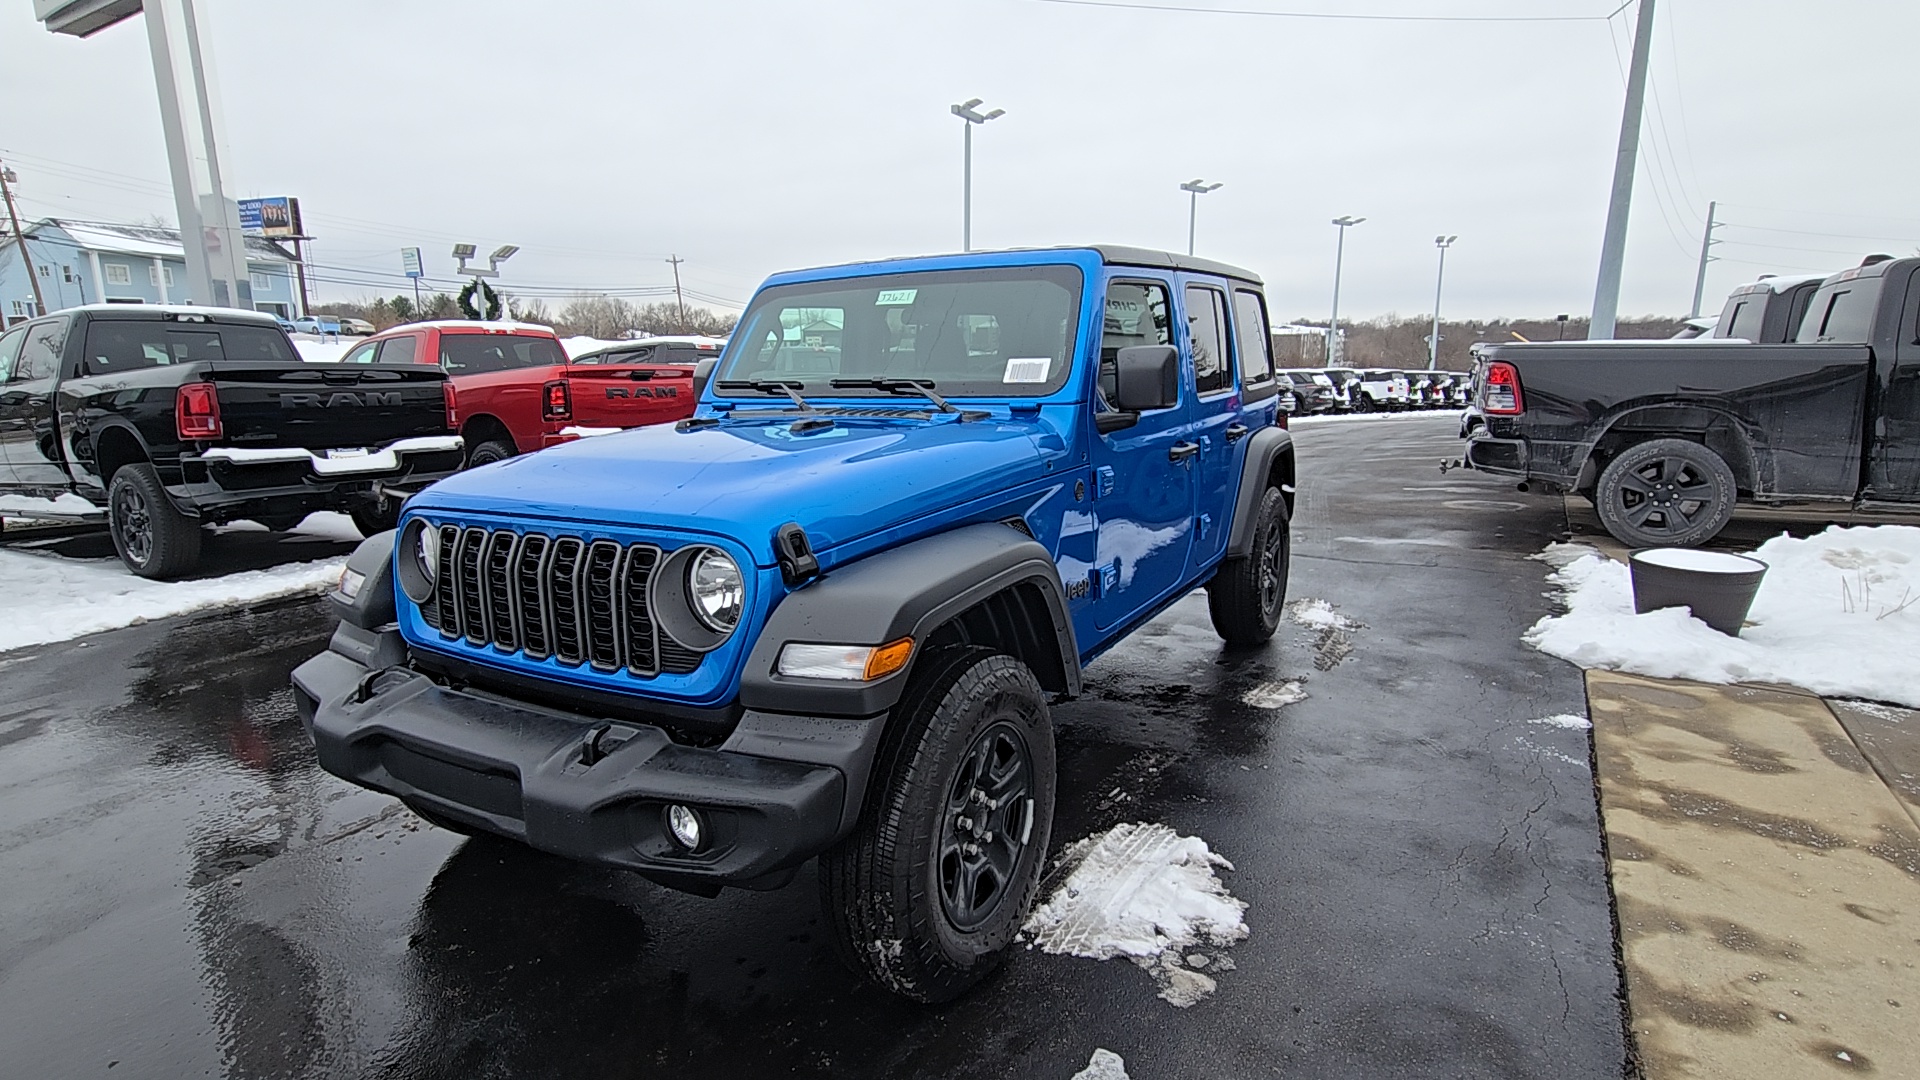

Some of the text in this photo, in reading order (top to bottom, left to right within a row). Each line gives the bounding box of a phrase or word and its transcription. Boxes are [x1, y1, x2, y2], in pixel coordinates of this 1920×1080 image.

[280, 392, 402, 408] RAM
[605, 387, 677, 399] RAM
[1065, 578, 1090, 600] Jeep
